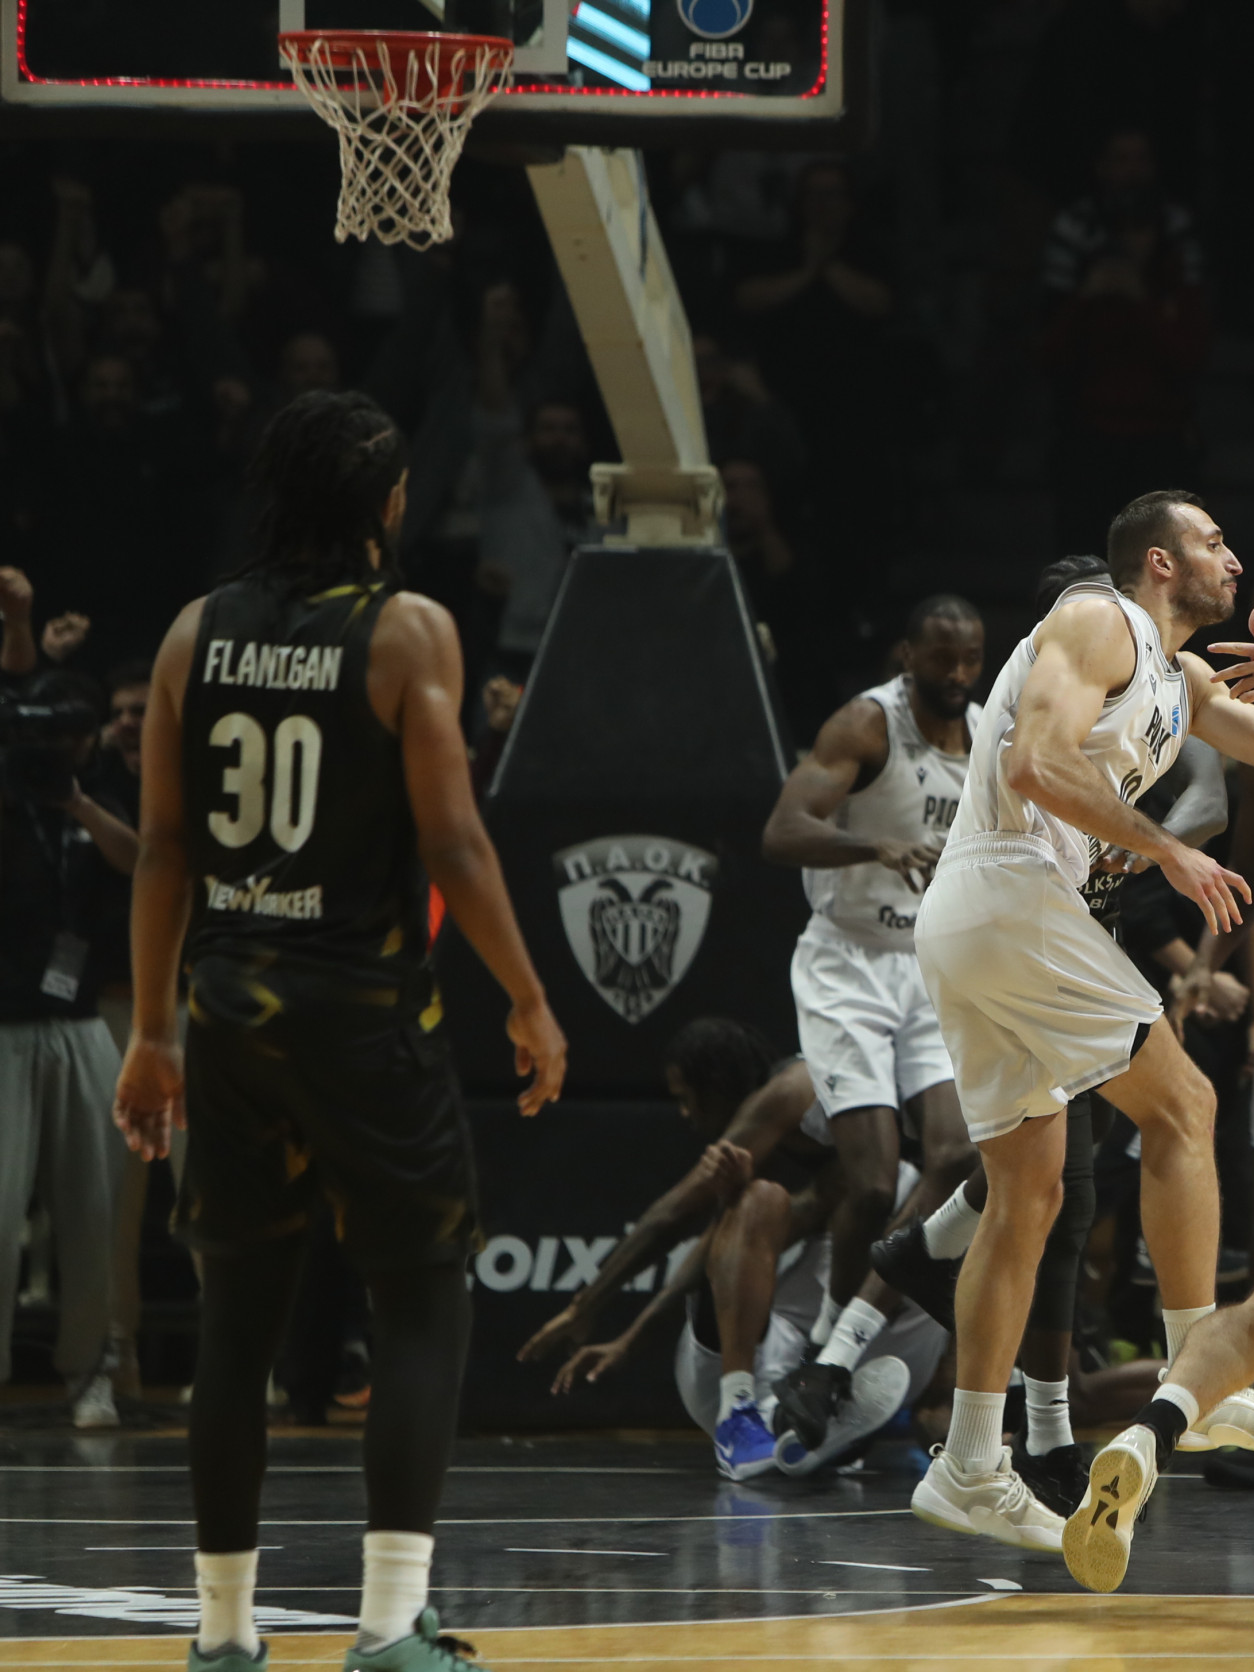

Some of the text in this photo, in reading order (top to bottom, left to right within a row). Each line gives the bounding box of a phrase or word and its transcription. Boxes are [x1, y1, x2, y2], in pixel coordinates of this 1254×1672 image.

[689, 42, 744, 60] FIBA
[642, 61, 792, 79] EUROPE CUP
[203, 639, 343, 691] FLANIGAN
[208, 712, 322, 853] 30
